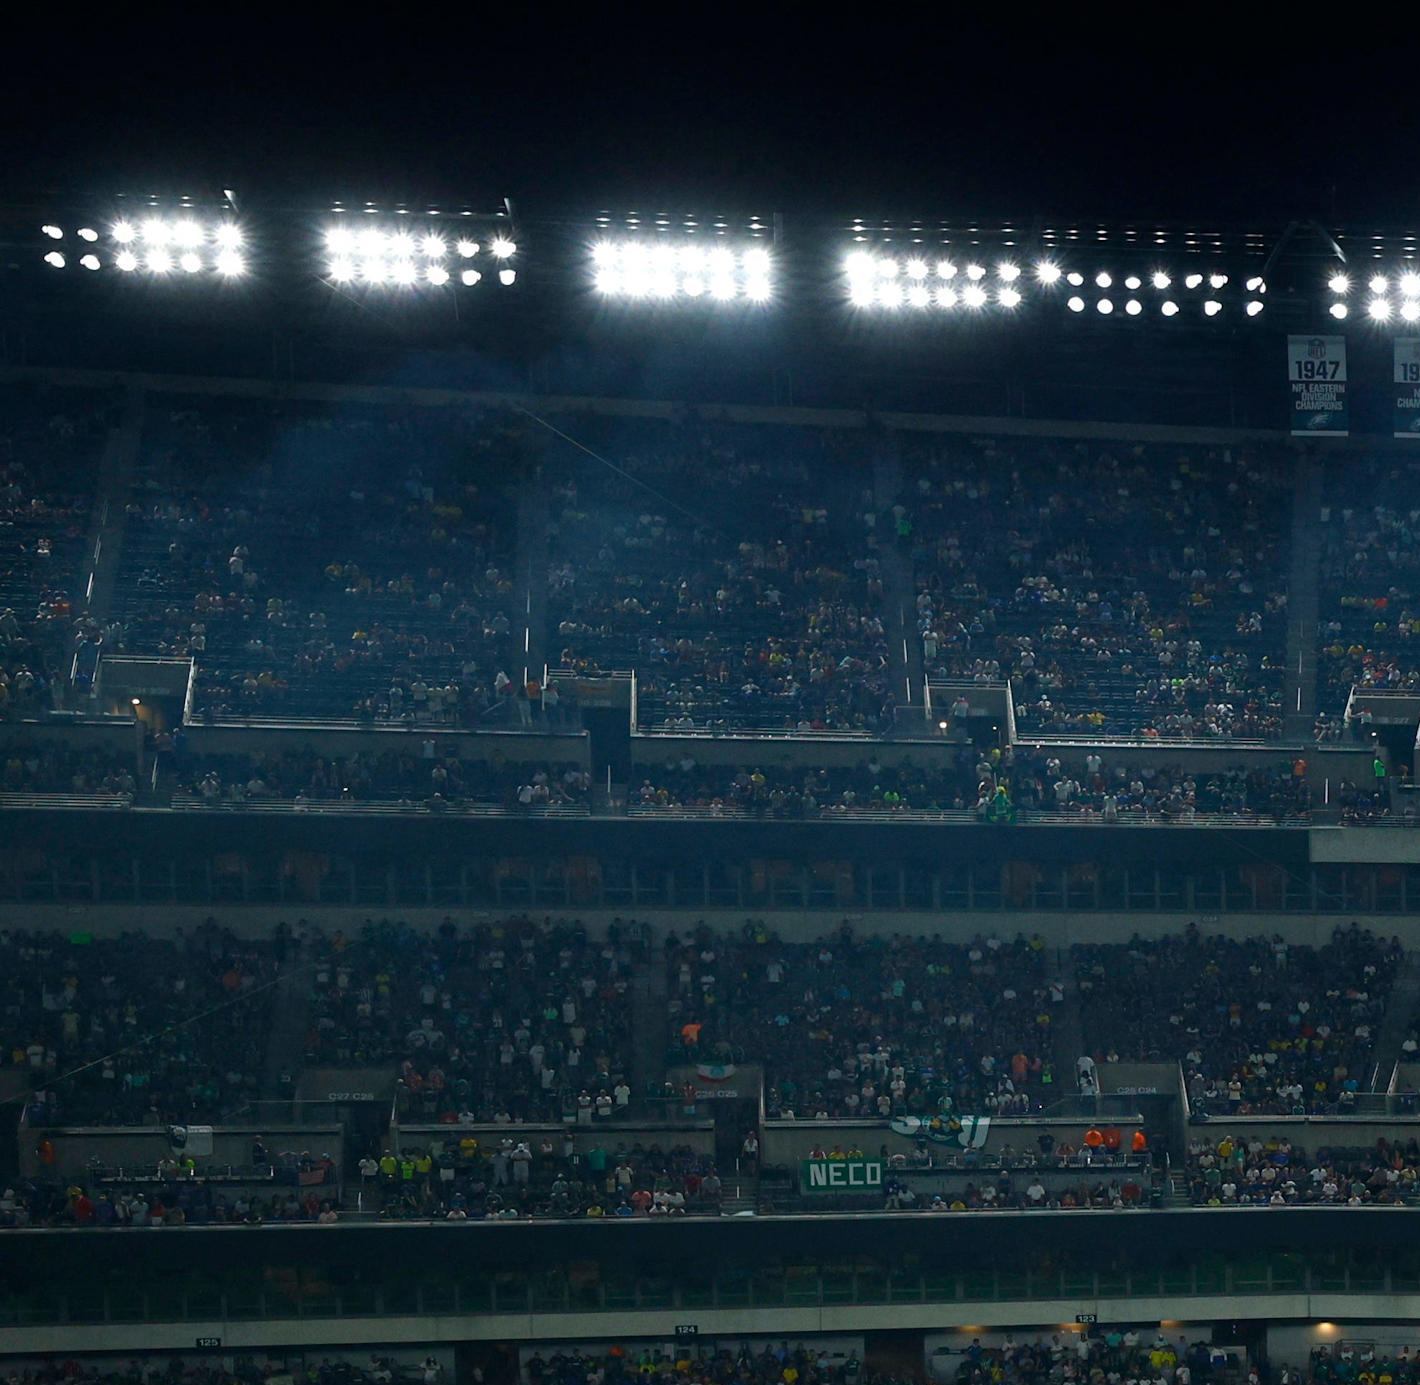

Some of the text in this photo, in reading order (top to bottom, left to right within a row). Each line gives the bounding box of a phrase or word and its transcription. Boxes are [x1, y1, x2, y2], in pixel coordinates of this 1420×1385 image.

[1295, 361, 1341, 380] 1947
[1291, 384, 1346, 394] NFL EASTERN
[1302, 393, 1337, 402] DIVISION
[1296, 401, 1344, 411] CHAMPIONS
[809, 1163, 881, 1186] NECO
[1078, 1315, 1095, 1323] 123
